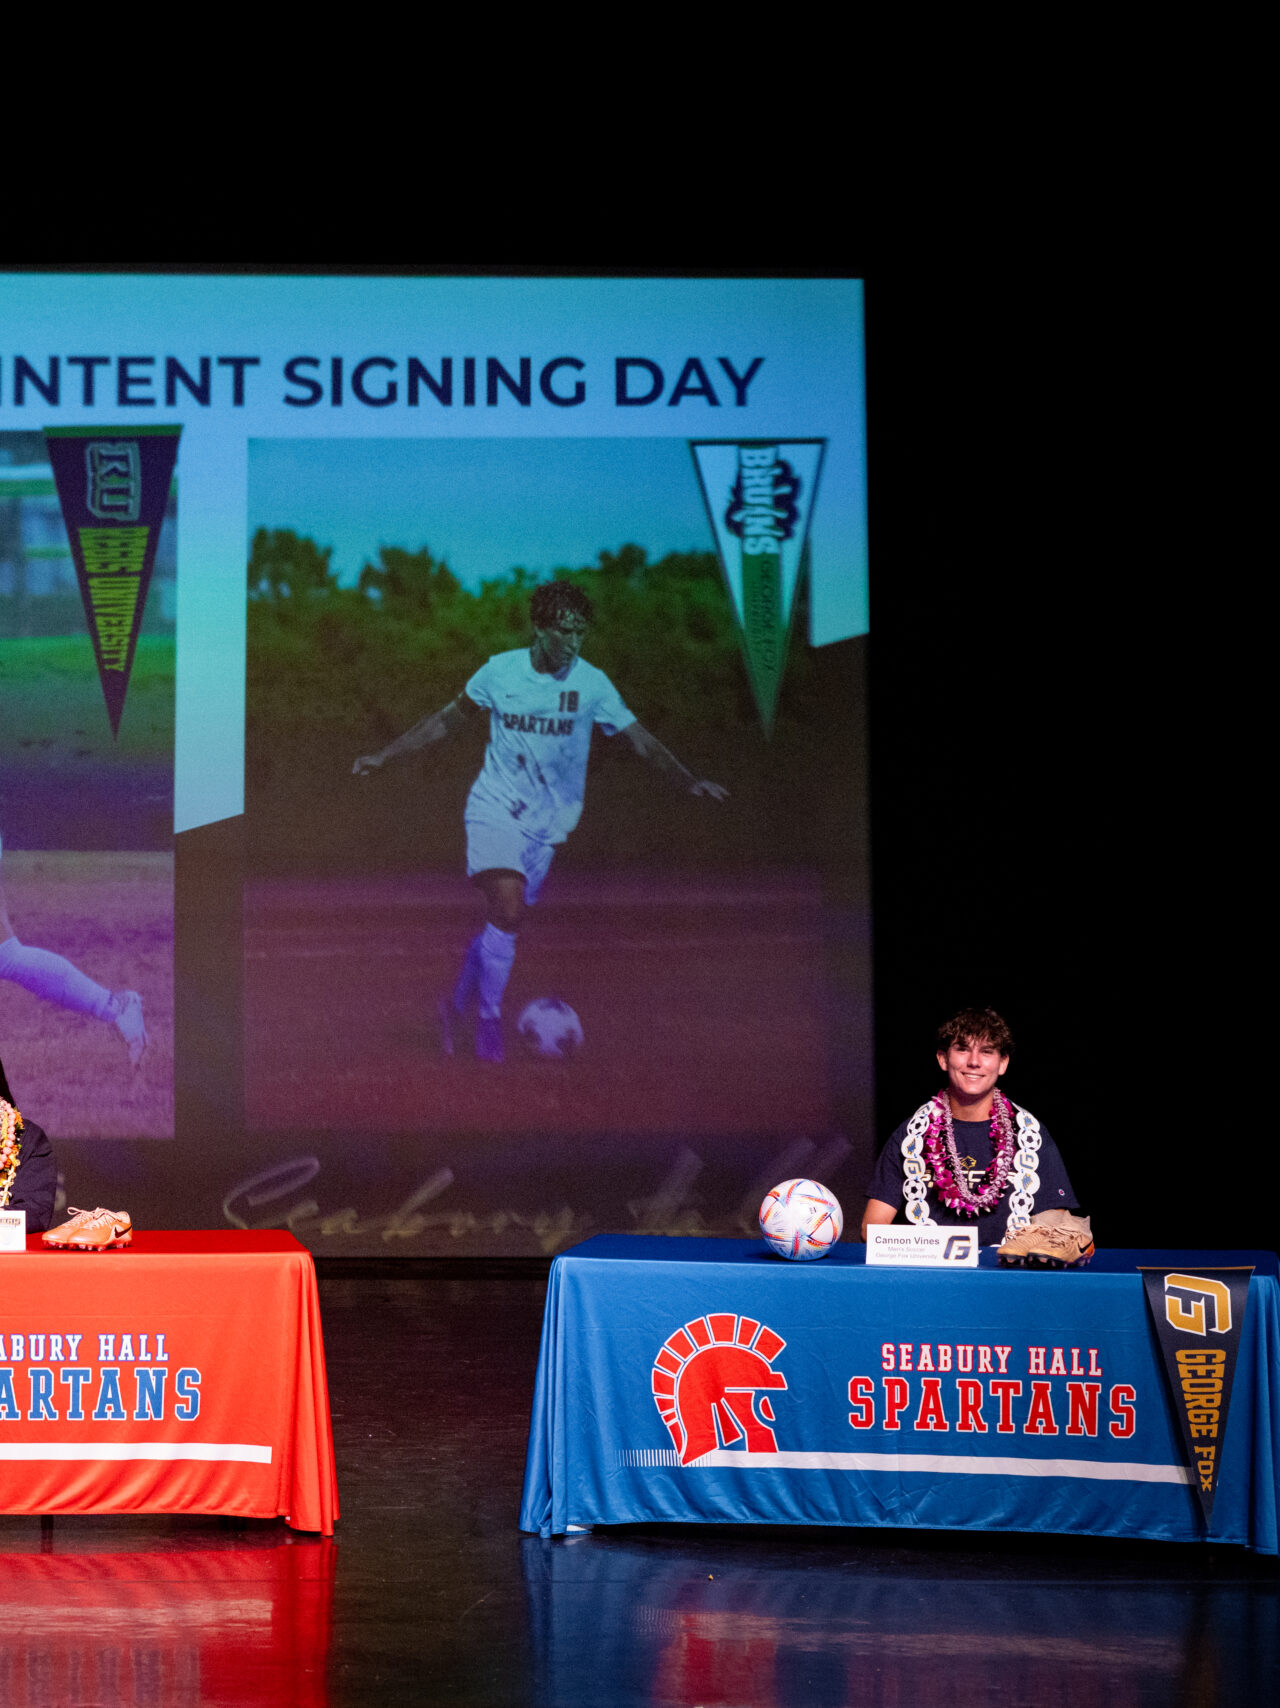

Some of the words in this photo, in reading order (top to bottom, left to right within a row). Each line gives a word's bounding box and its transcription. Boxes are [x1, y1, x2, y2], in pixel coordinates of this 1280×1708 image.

[282, 356, 587, 408] SIGNING
[614, 357, 766, 407] DAY
[87, 576, 141, 672] UNIVERSITY
[502, 713, 575, 736] SPARTANS
[874, 1235, 912, 1245] Cannon
[913, 1236, 940, 1245] Vines
[97, 1333, 170, 1362] HALL
[880, 1342, 1013, 1375] SEABURY
[1027, 1346, 1103, 1377] HALL
[847, 1375, 1138, 1439] SPARTANS
[1175, 1349, 1226, 1438] GEORGE
[1193, 1445, 1216, 1492] FOX
